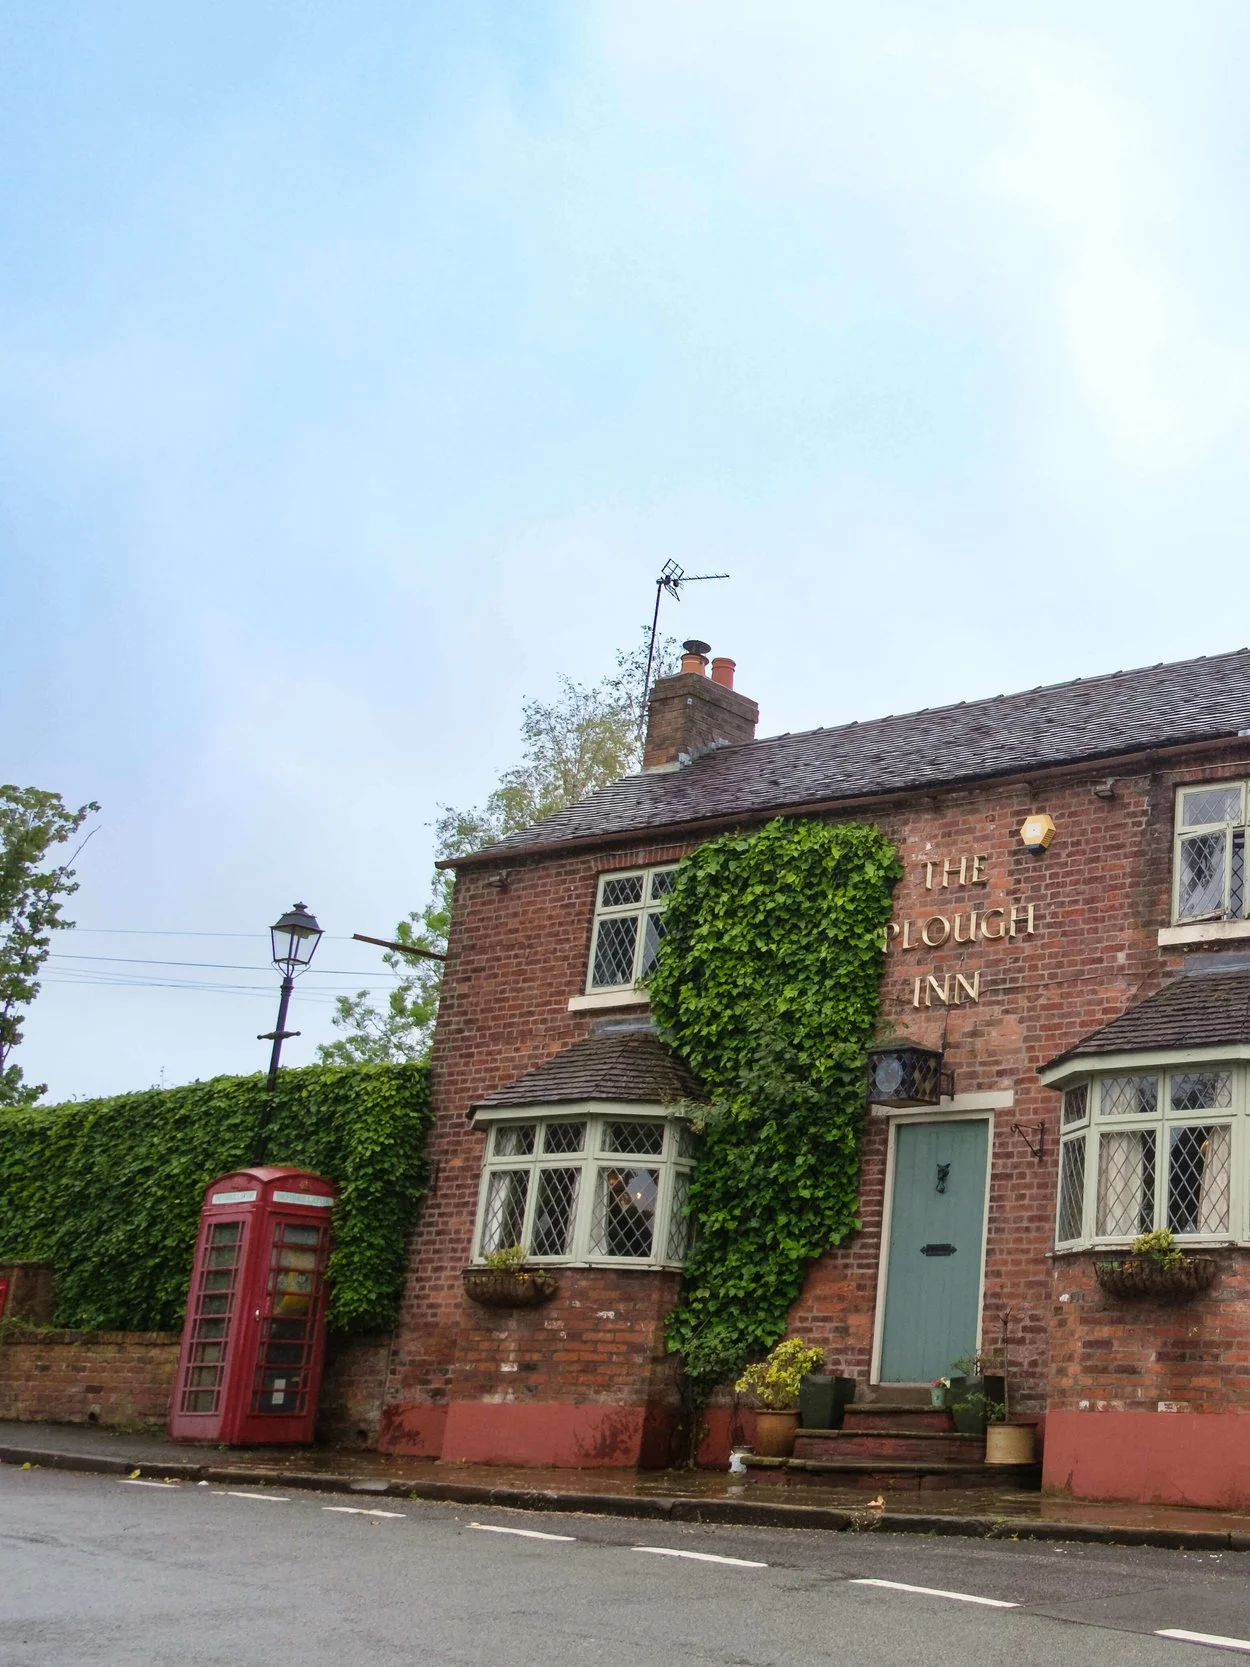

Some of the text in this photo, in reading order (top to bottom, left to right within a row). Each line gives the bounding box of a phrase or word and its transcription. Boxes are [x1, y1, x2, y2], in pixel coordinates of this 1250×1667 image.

[921, 854, 989, 890] THE
[882, 903, 1034, 953] PLOUGH
[913, 971, 980, 1008] INN
